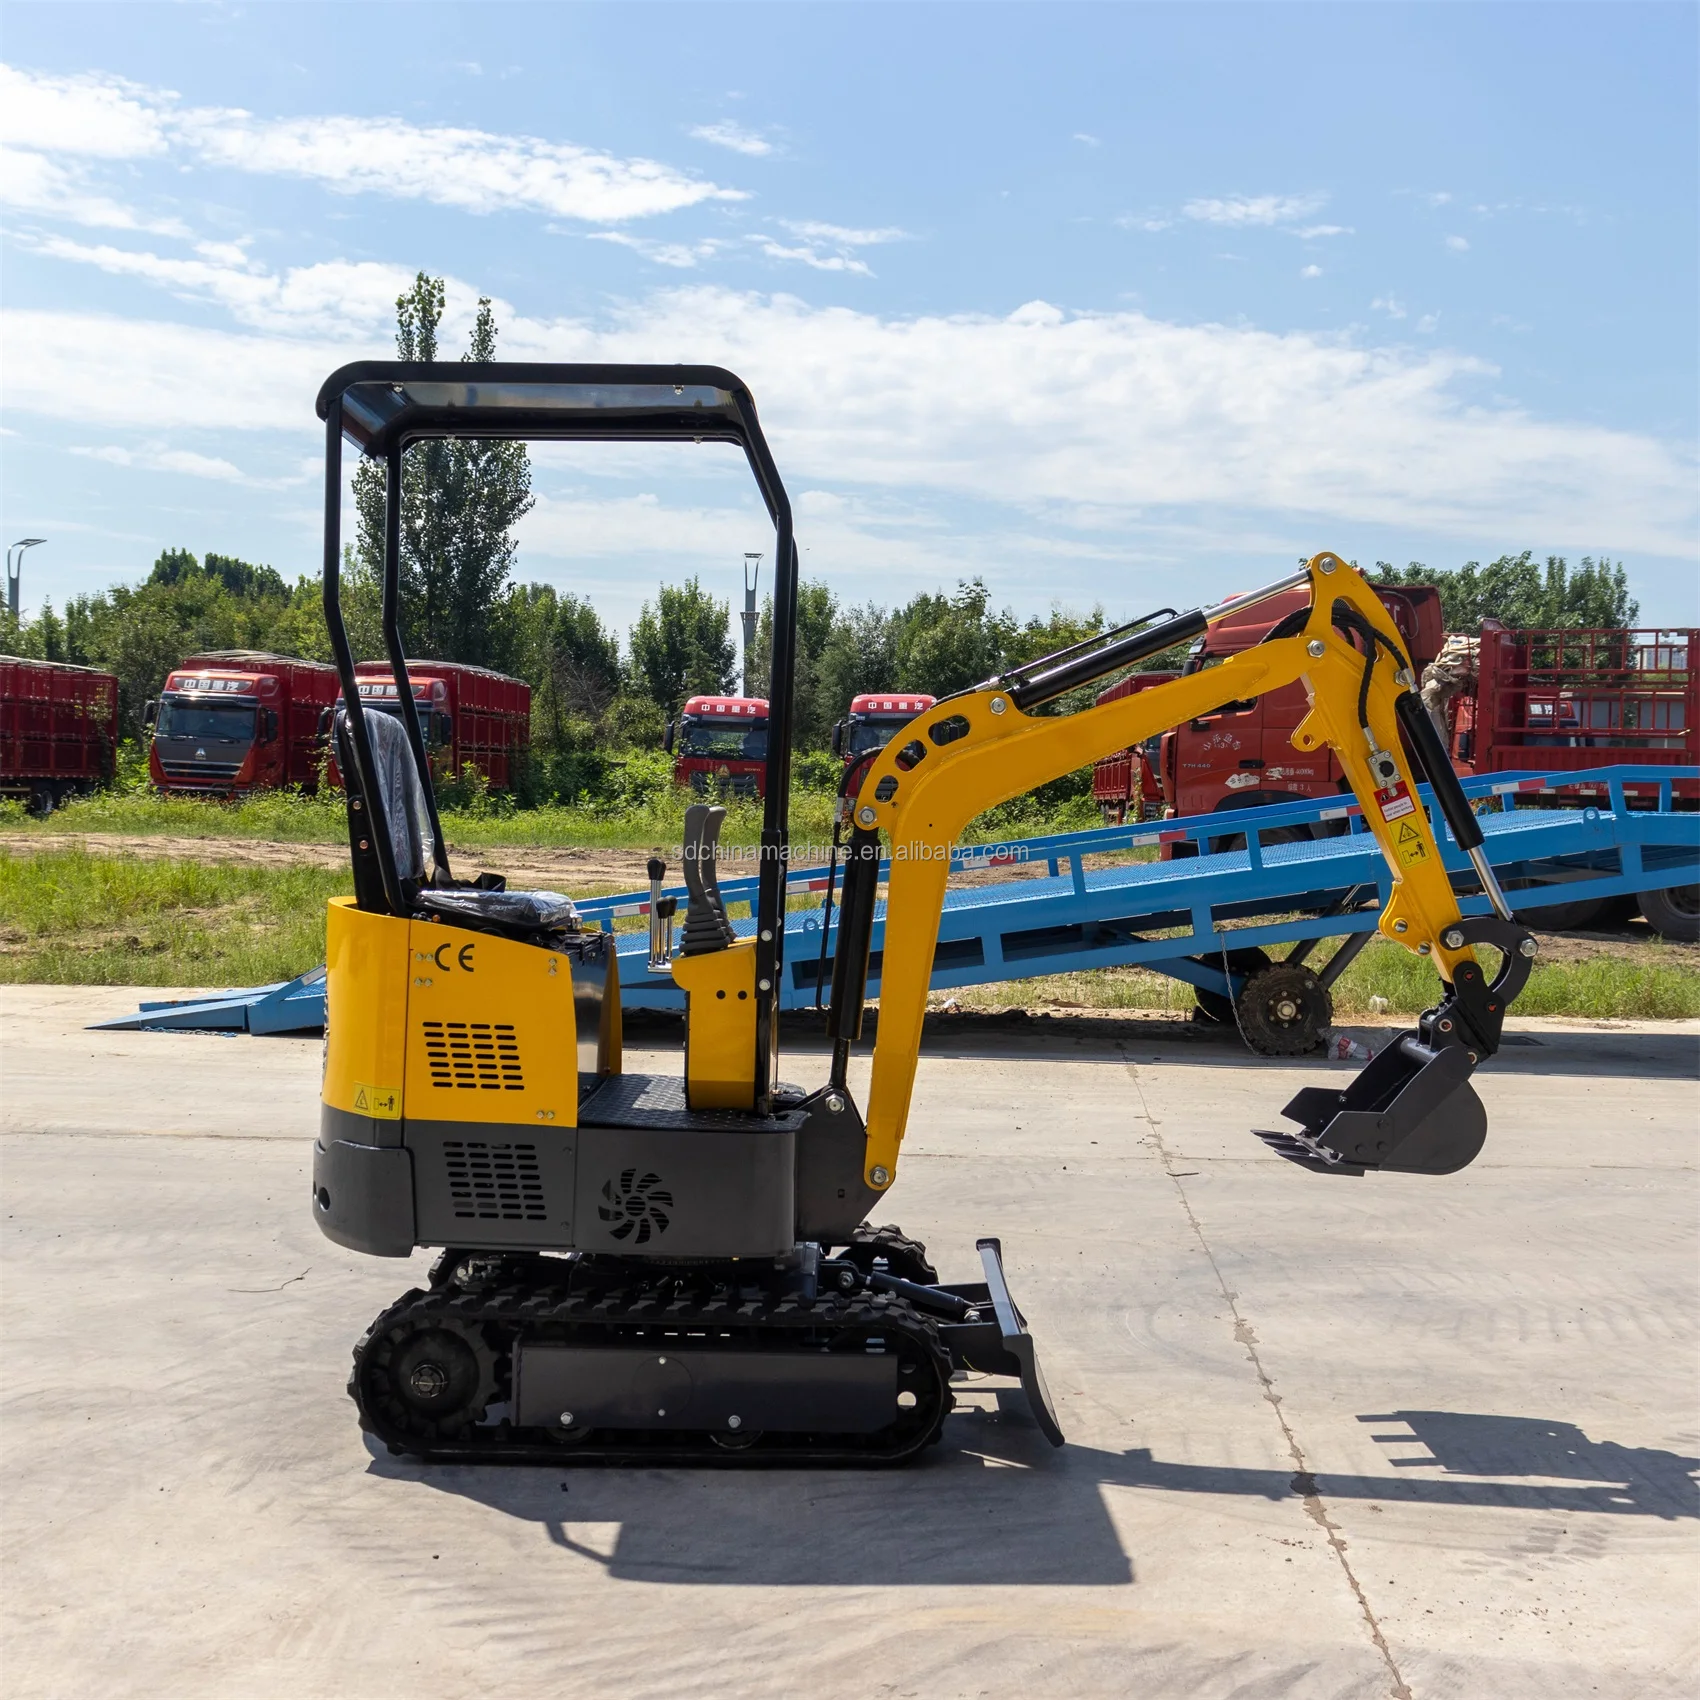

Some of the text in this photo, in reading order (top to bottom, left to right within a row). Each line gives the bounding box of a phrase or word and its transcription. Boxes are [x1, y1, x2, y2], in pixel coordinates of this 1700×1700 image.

[184, 679, 239, 691] 中国重汽
[358, 685, 398, 695] 中国重
[701, 704, 756, 714] 中国重汽
[868, 701, 923, 710] 中国重汽
[434, 943, 475, 972] CE
